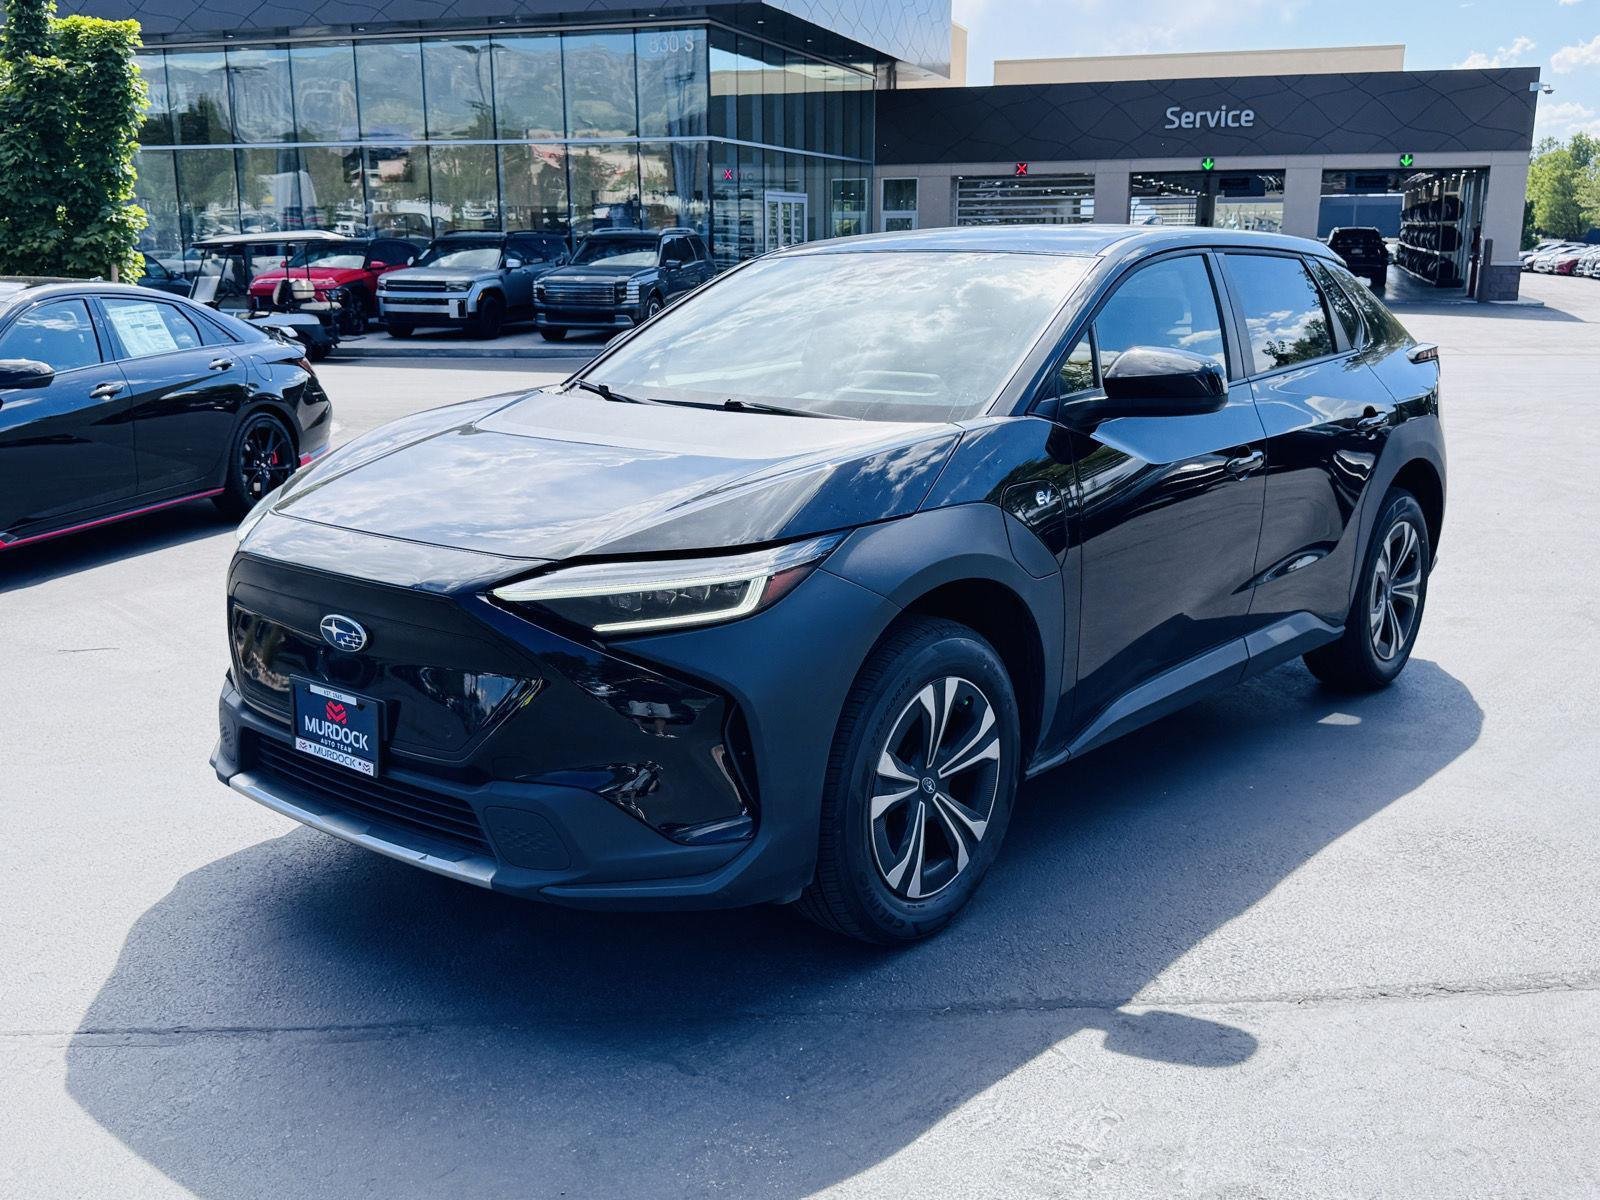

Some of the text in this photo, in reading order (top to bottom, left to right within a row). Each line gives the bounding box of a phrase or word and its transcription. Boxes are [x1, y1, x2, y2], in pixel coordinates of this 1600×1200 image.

[684, 33, 694, 52] S
[1164, 105, 1255, 129] Service
[304, 715, 369, 751] MURDOCK
[313, 744, 357, 768] MURDOCK
[320, 738, 352, 753] AUTO TEAM
